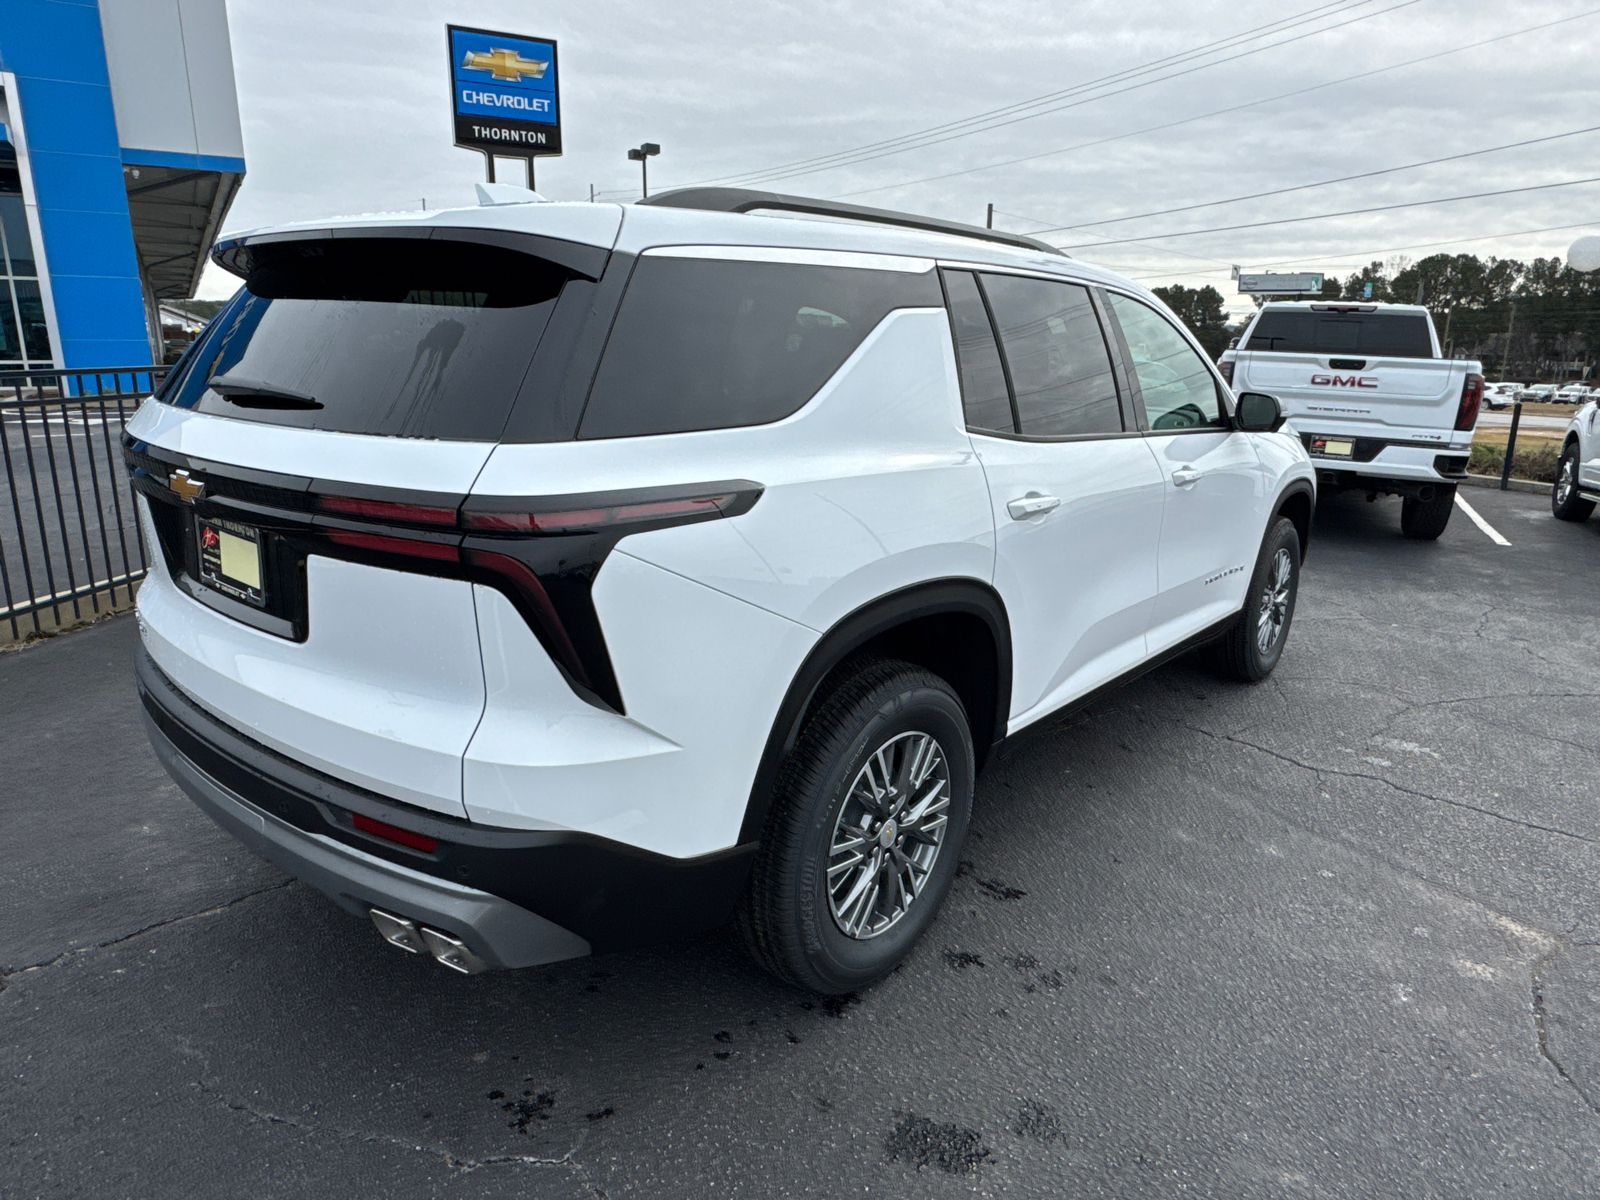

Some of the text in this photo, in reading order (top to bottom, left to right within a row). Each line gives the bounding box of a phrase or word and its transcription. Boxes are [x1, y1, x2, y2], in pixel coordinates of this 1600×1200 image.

[462, 89, 551, 113] CHEVROLET
[472, 125, 546, 144] THORNTON
[1310, 374, 1379, 389] GMC
